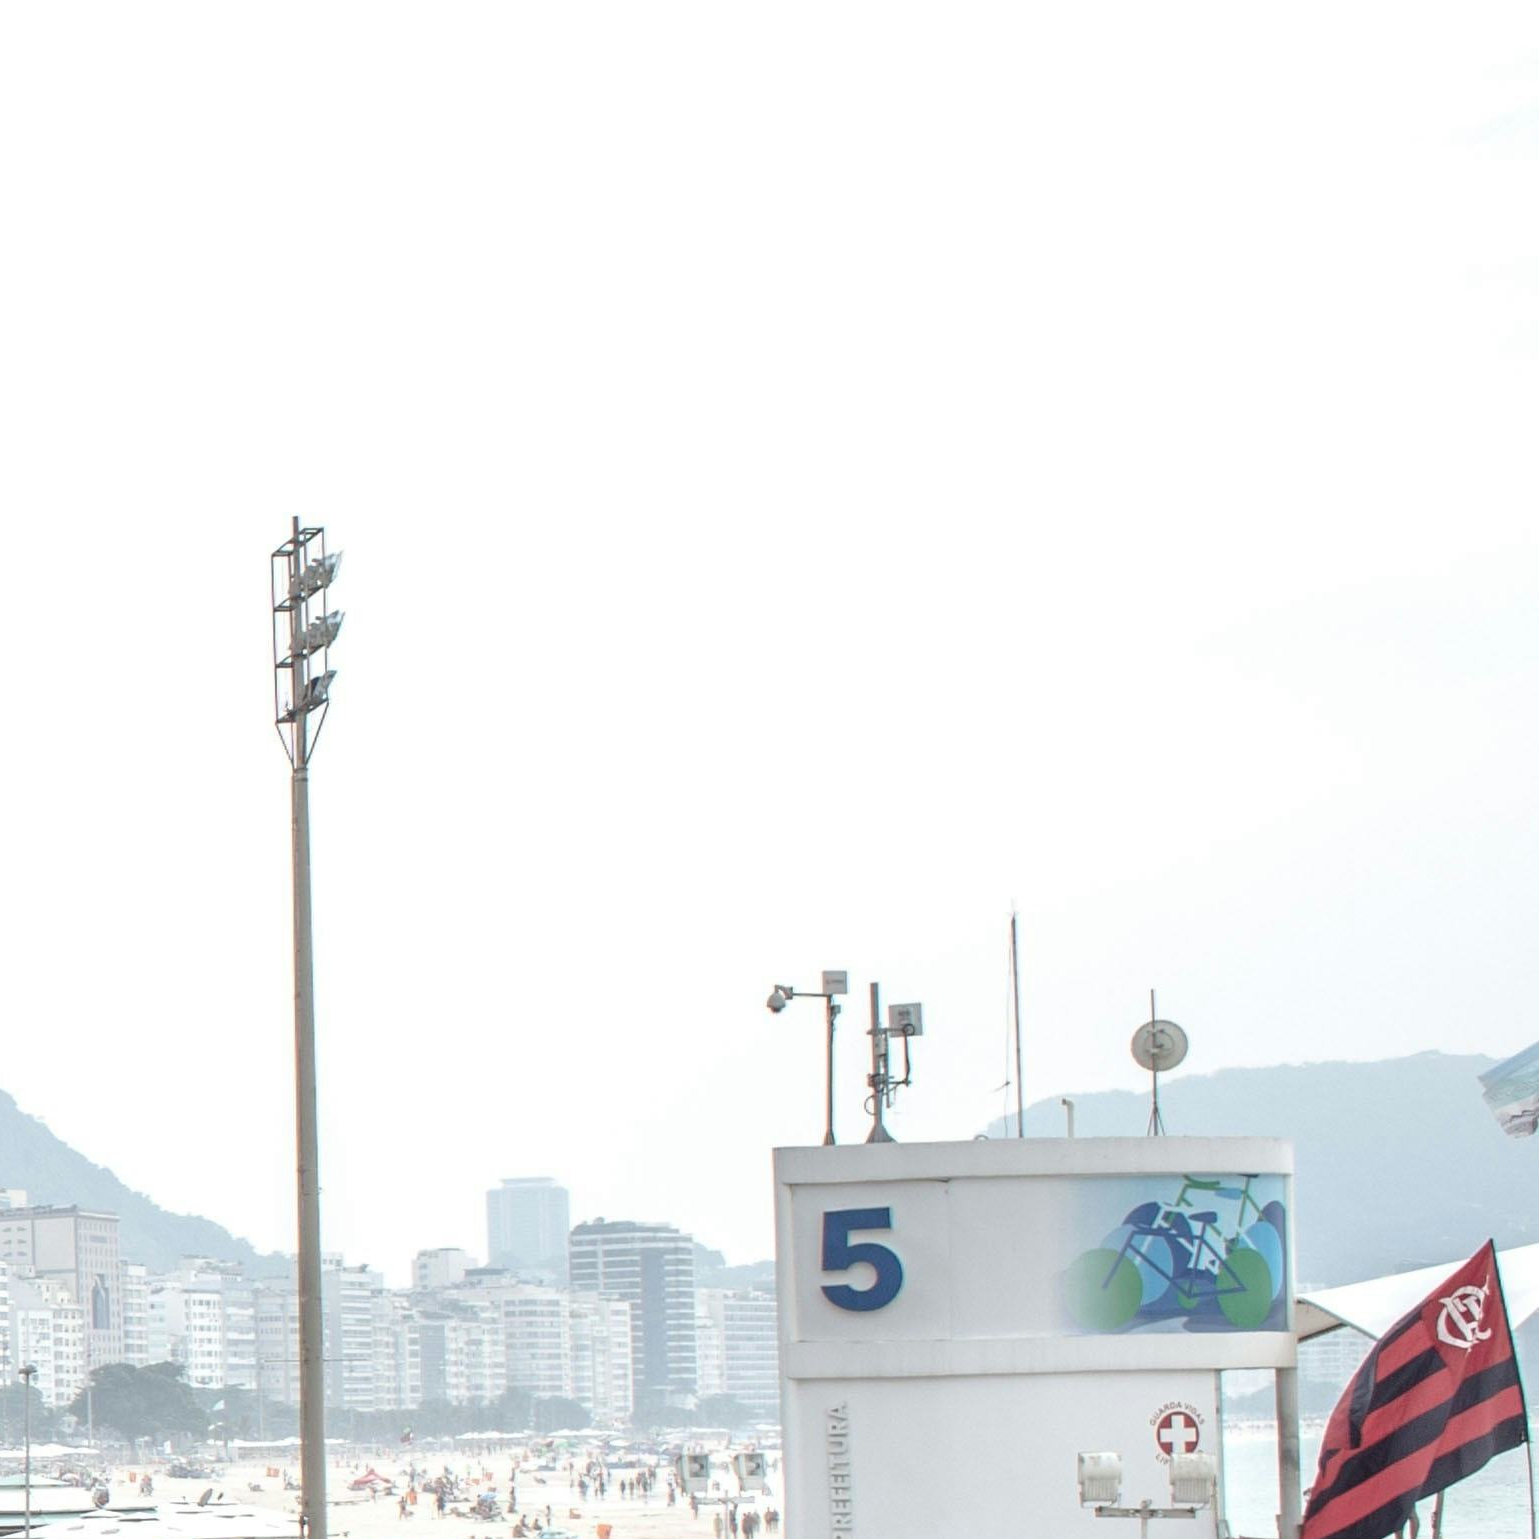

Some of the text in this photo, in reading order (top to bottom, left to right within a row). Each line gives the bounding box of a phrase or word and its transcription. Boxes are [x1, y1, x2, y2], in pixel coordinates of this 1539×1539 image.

[820, 1206, 904, 1313] 5
[1149, 1401, 1205, 1426] GUARDA VIDAS
